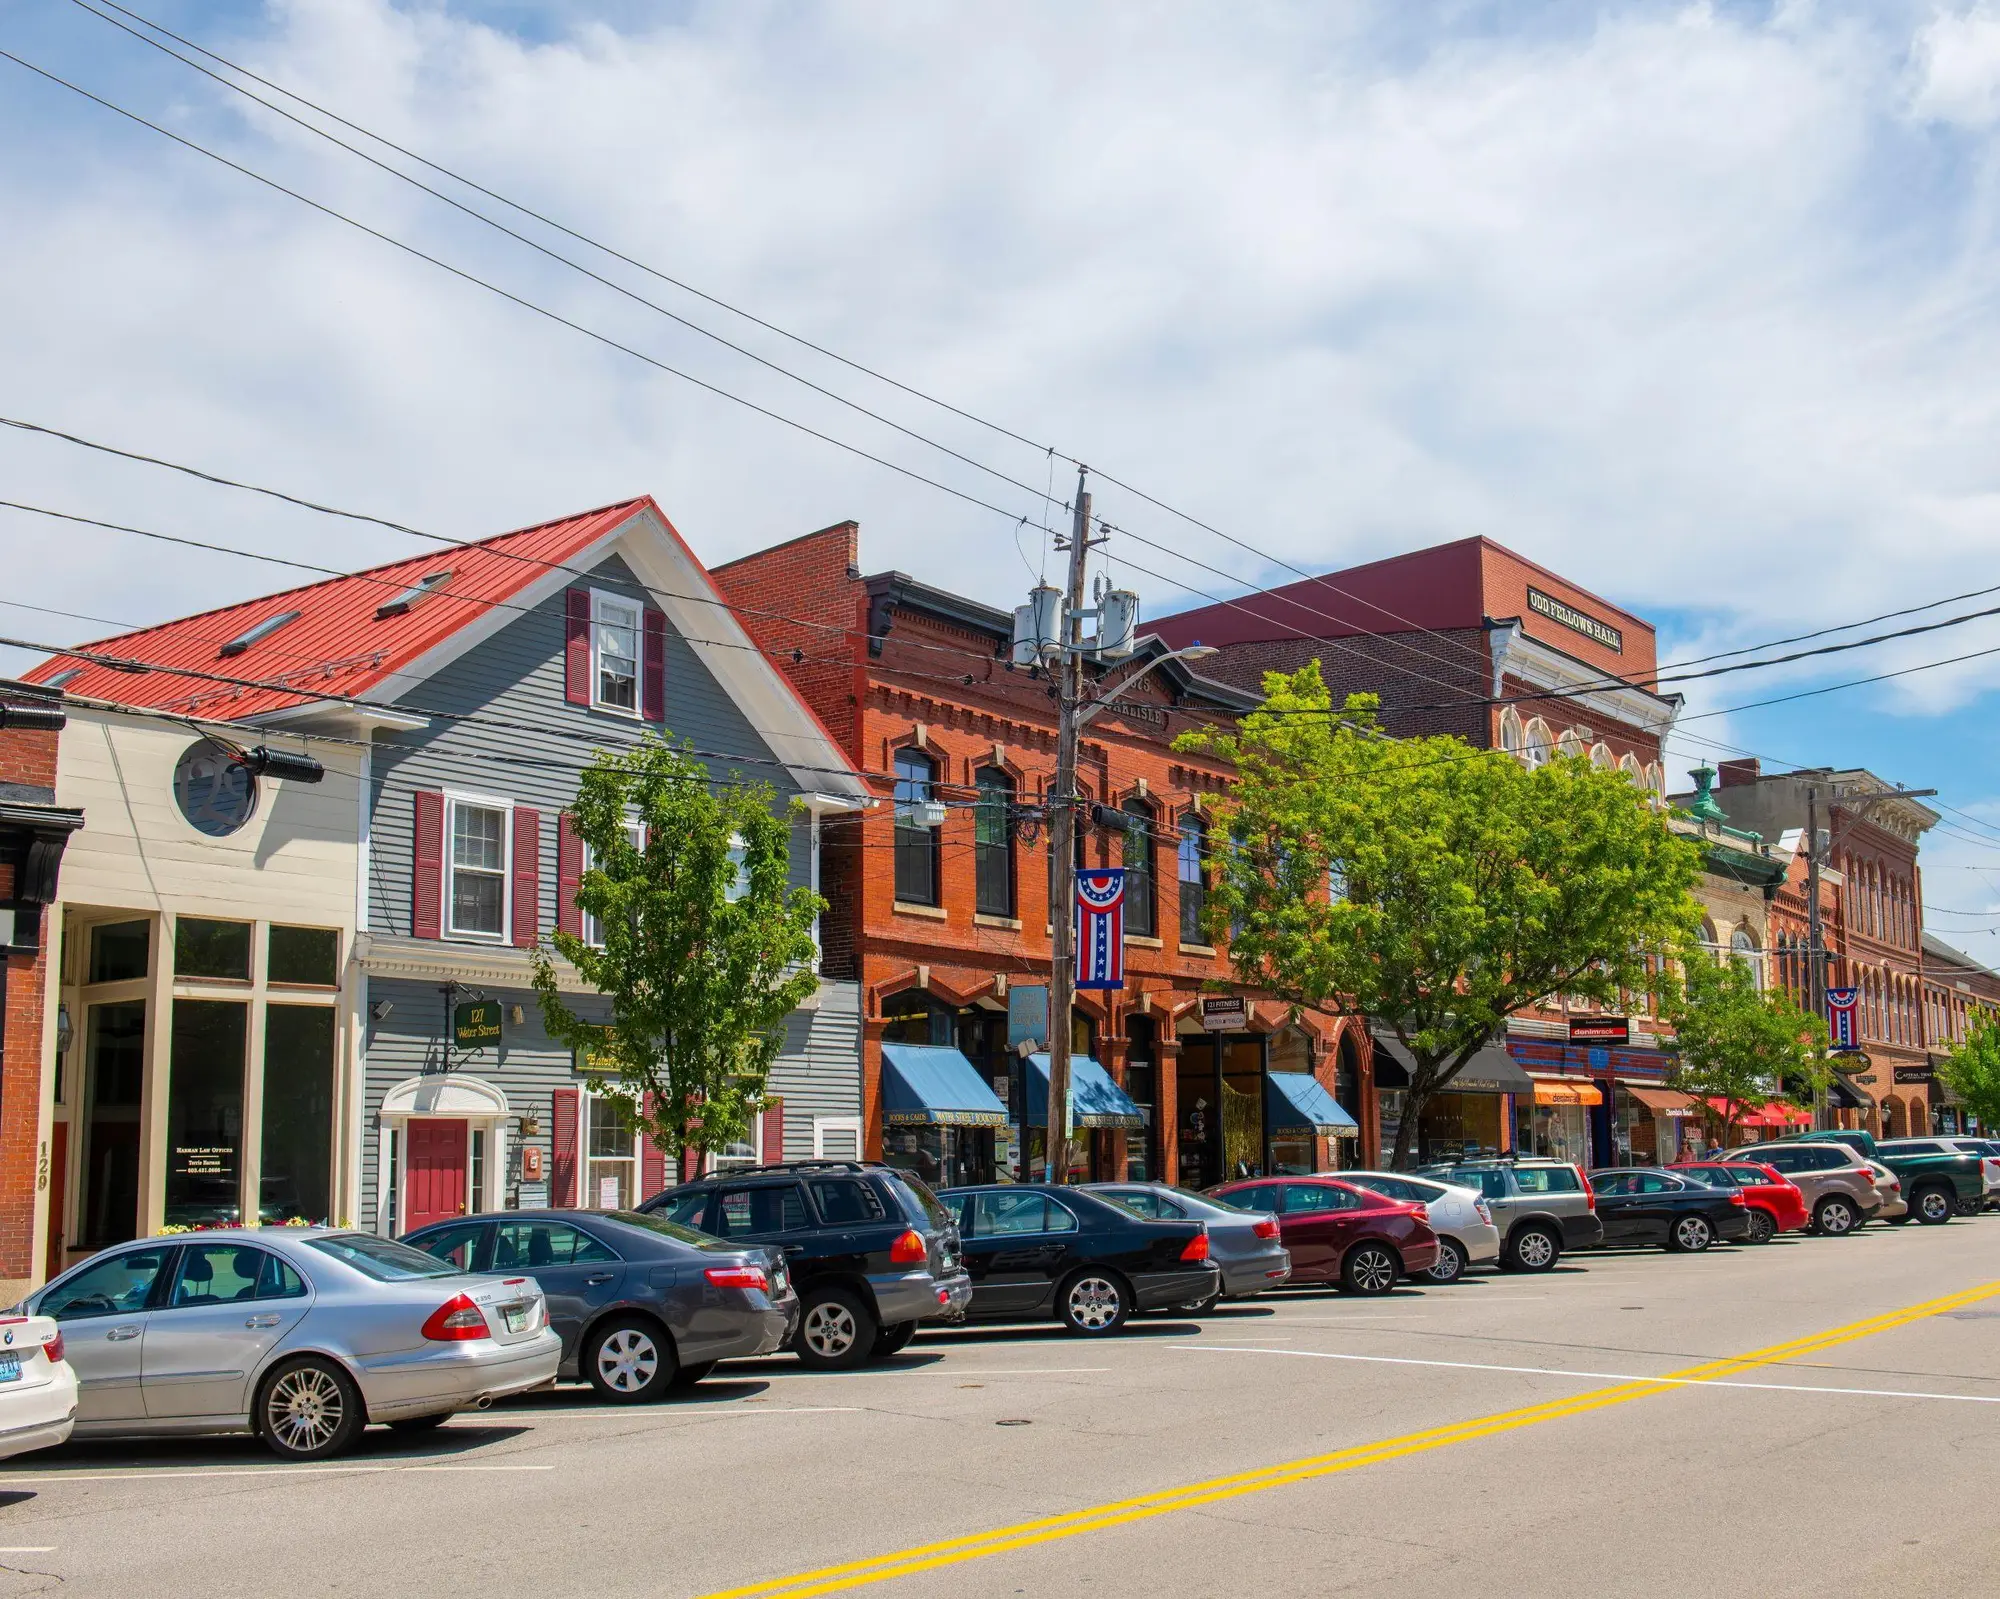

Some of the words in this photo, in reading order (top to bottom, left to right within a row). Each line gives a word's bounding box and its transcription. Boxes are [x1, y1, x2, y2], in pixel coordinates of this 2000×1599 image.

[1530, 592, 1549, 613] ODD
[1549, 601, 1593, 634] FELLOWS
[1593, 623, 1619, 647] HALL
[1215, 1000, 1240, 1008] FITNESS
[471, 1008, 485, 1023] 127
[456, 1026, 478, 1039] Water
[478, 1024, 500, 1037] Street
[1894, 1070, 1920, 1080] CAPITAL
[888, 1113, 905, 1121] BOOKS
[910, 1112, 927, 1121] CARDS
[934, 1111, 955, 1122] WATER
[955, 1111, 974, 1123] STREET
[975, 1112, 1006, 1124] BOOKSTORE
[1097, 1115, 1114, 1125] STREET
[1114, 1115, 1141, 1126] BOOKSTORE
[38, 1141, 48, 1191] 129
[480, 1294, 492, 1302] 350
